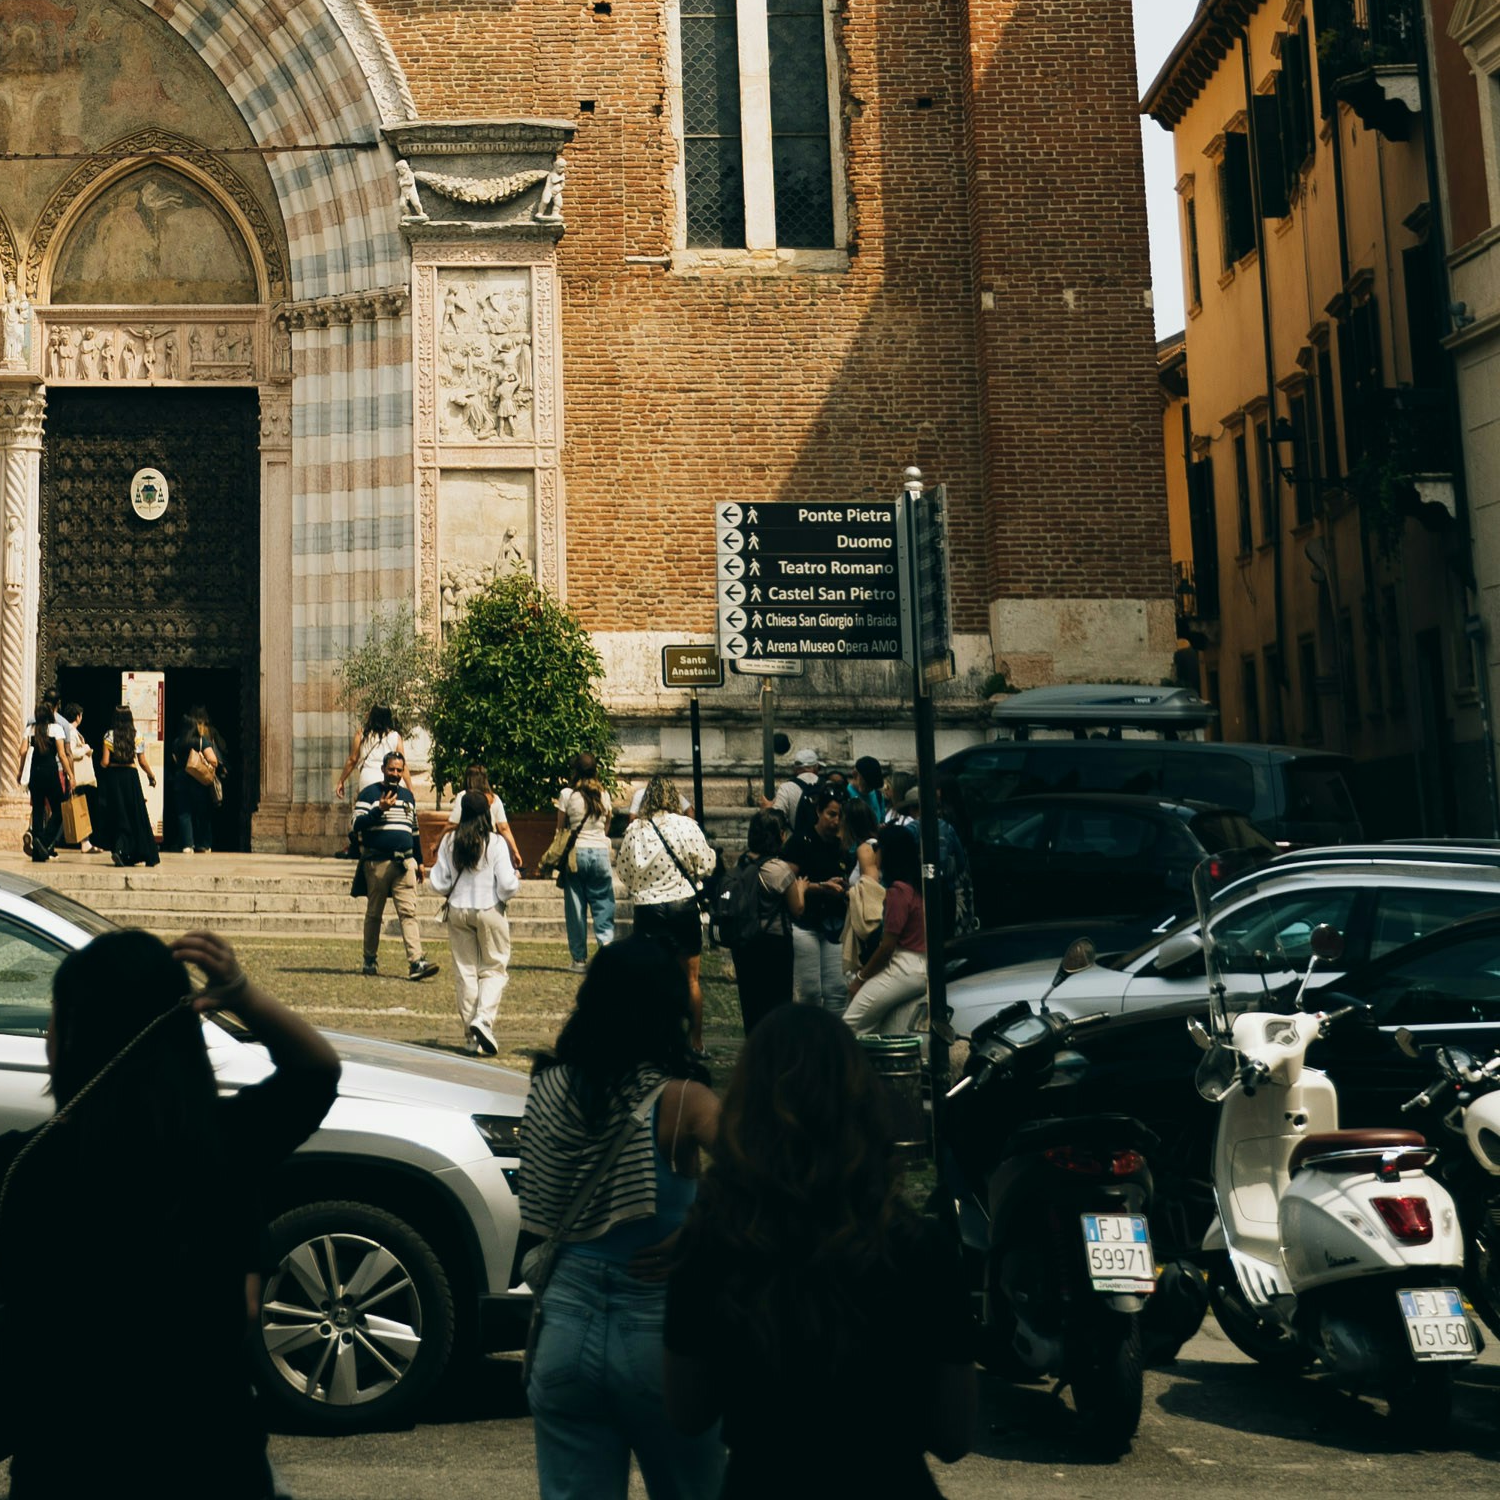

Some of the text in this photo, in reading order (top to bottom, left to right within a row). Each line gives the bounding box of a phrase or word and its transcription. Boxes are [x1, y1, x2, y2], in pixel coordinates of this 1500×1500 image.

[798, 508, 891, 522] Ponte Pietra
[836, 534, 893, 548] Duomo
[778, 561, 894, 574] Teatro Romano
[768, 586, 896, 600] Castel San Pietro
[765, 613, 898, 630] Chiesa San Giorgio in Braida
[766, 639, 898, 655] Arena Museo Opera AMO
[679, 655, 707, 665] Santa
[671, 666, 716, 676] Anastasia
[1098, 1218, 1122, 1241] FJ
[1091, 1248, 1146, 1271] 59971
[1414, 1292, 1439, 1315] FJ
[1412, 1323, 1469, 1347] 15150
